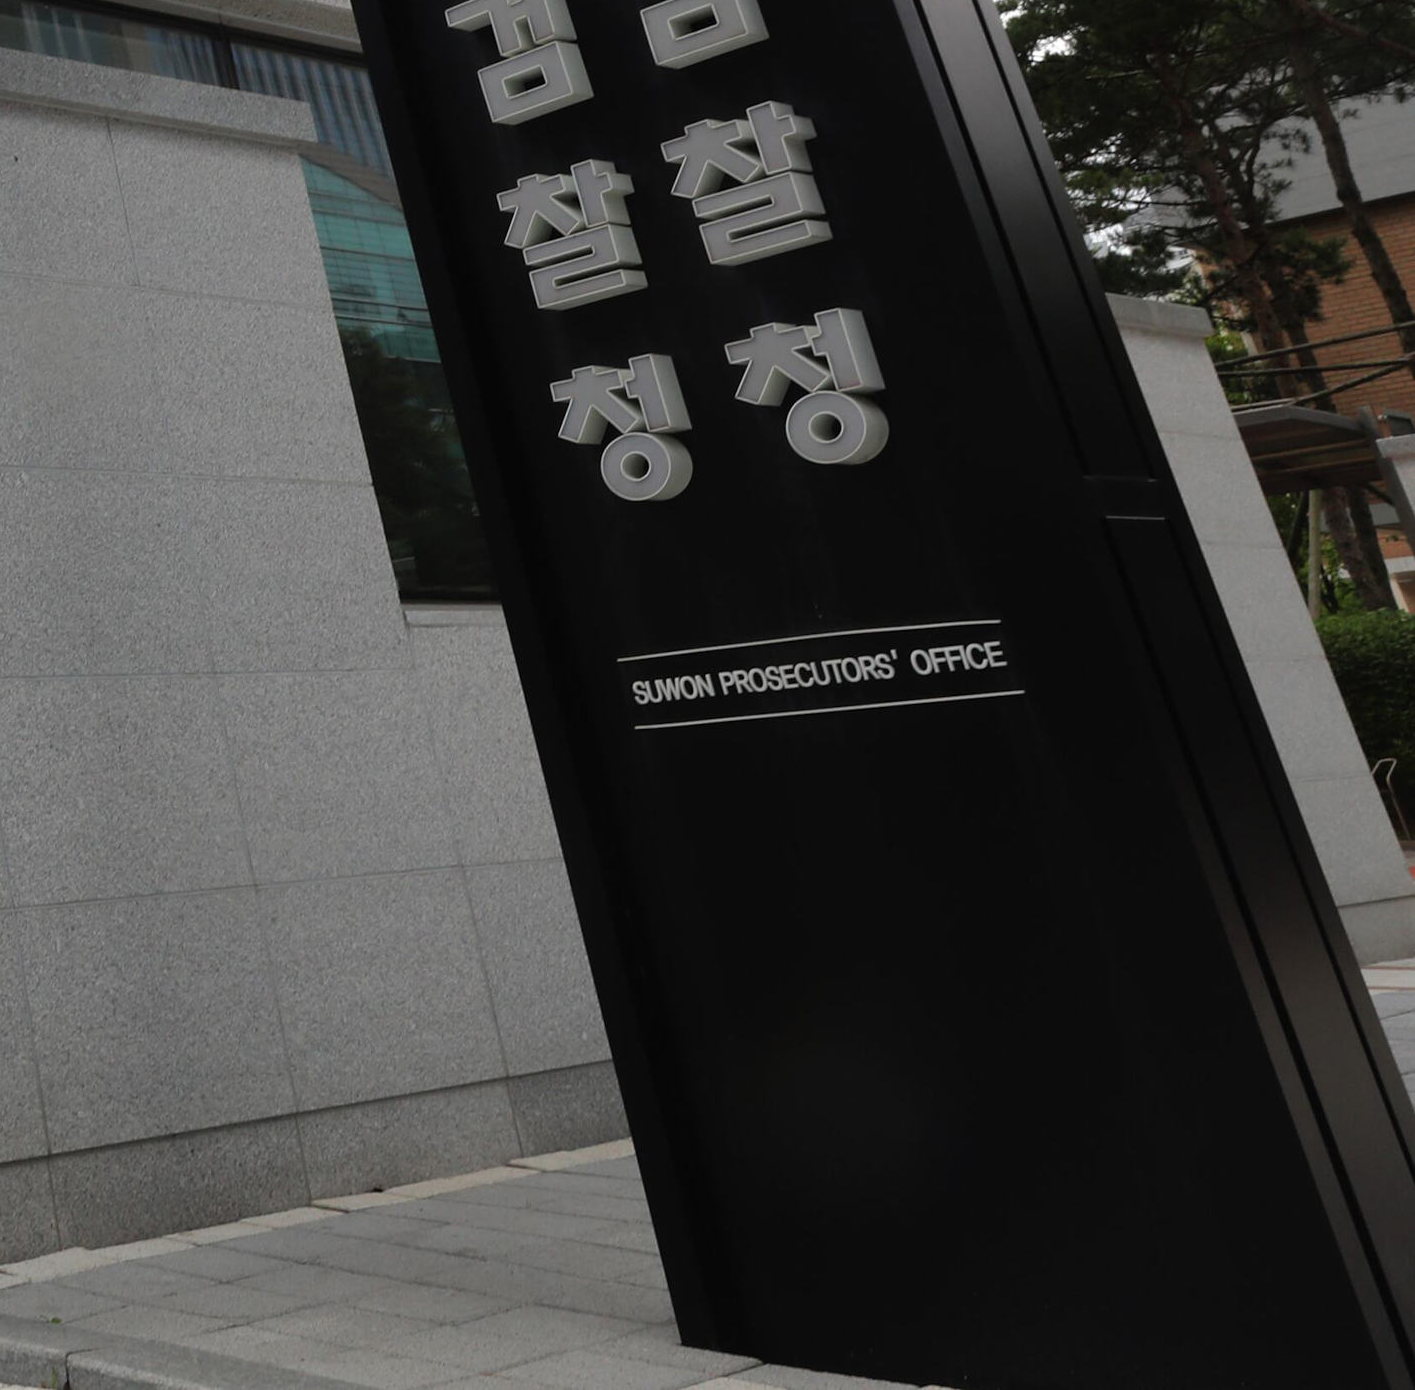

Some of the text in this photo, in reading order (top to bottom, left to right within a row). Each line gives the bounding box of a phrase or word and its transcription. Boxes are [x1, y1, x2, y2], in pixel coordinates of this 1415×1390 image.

[632, 640, 1008, 705] SUWON PROSECUTORS' OFFICE
